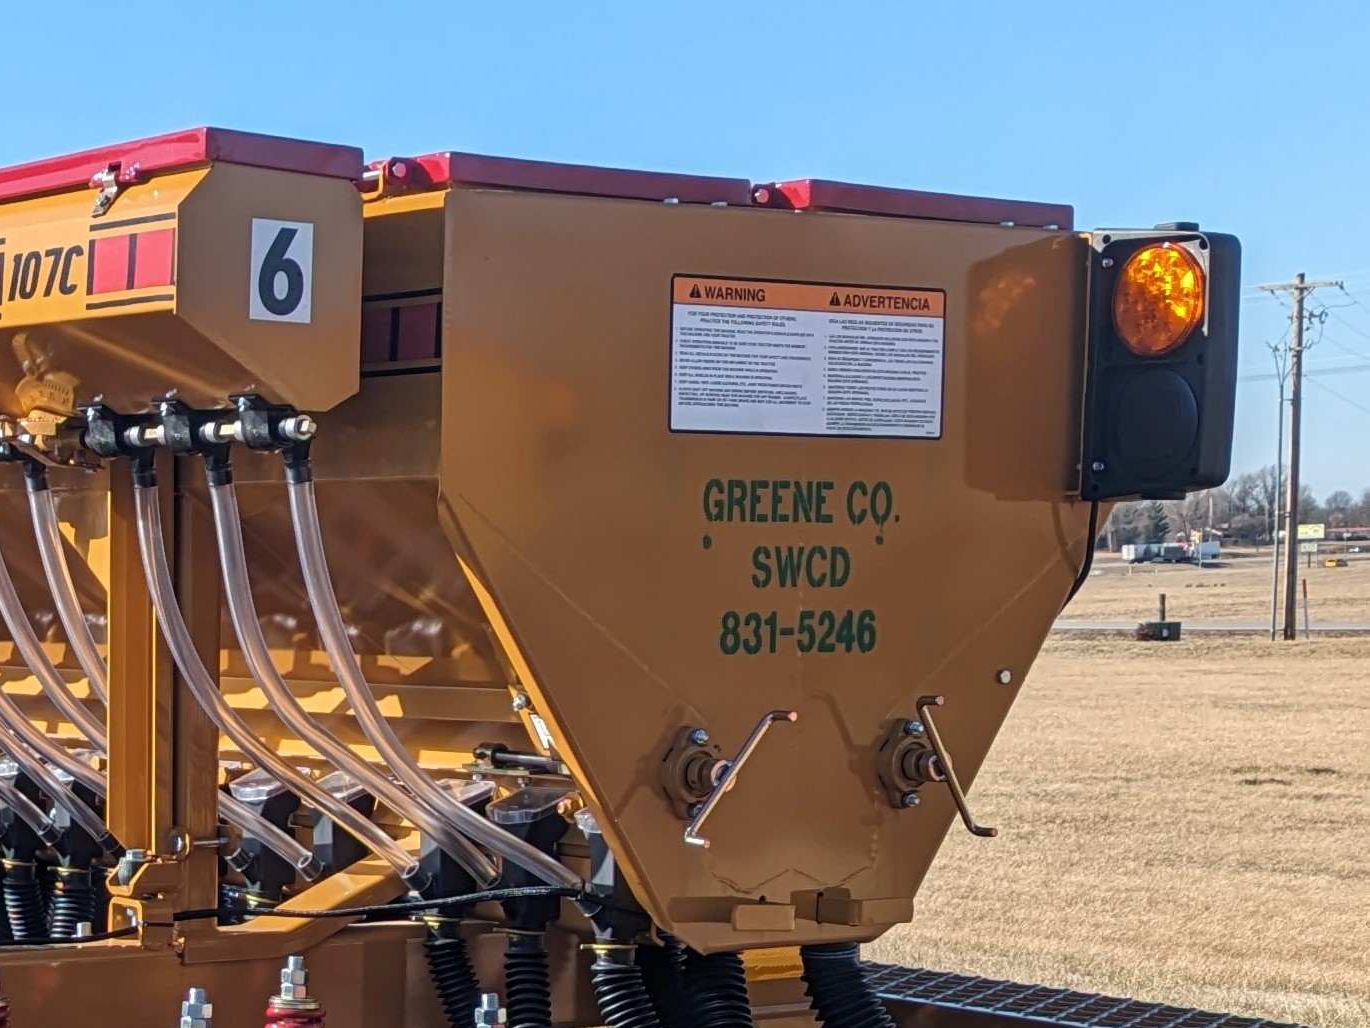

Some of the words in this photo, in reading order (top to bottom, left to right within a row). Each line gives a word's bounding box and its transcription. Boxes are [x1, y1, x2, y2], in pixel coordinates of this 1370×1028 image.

[7, 245, 84, 302] 107C
[258, 227, 304, 316] 6
[704, 286, 766, 302] WARNING
[843, 294, 930, 311] ADVERTENCIA
[703, 478, 834, 523] GREENE
[846, 481, 900, 525] CO.
[752, 545, 850, 588] SWCD
[720, 609, 876, 655] 831-5246
